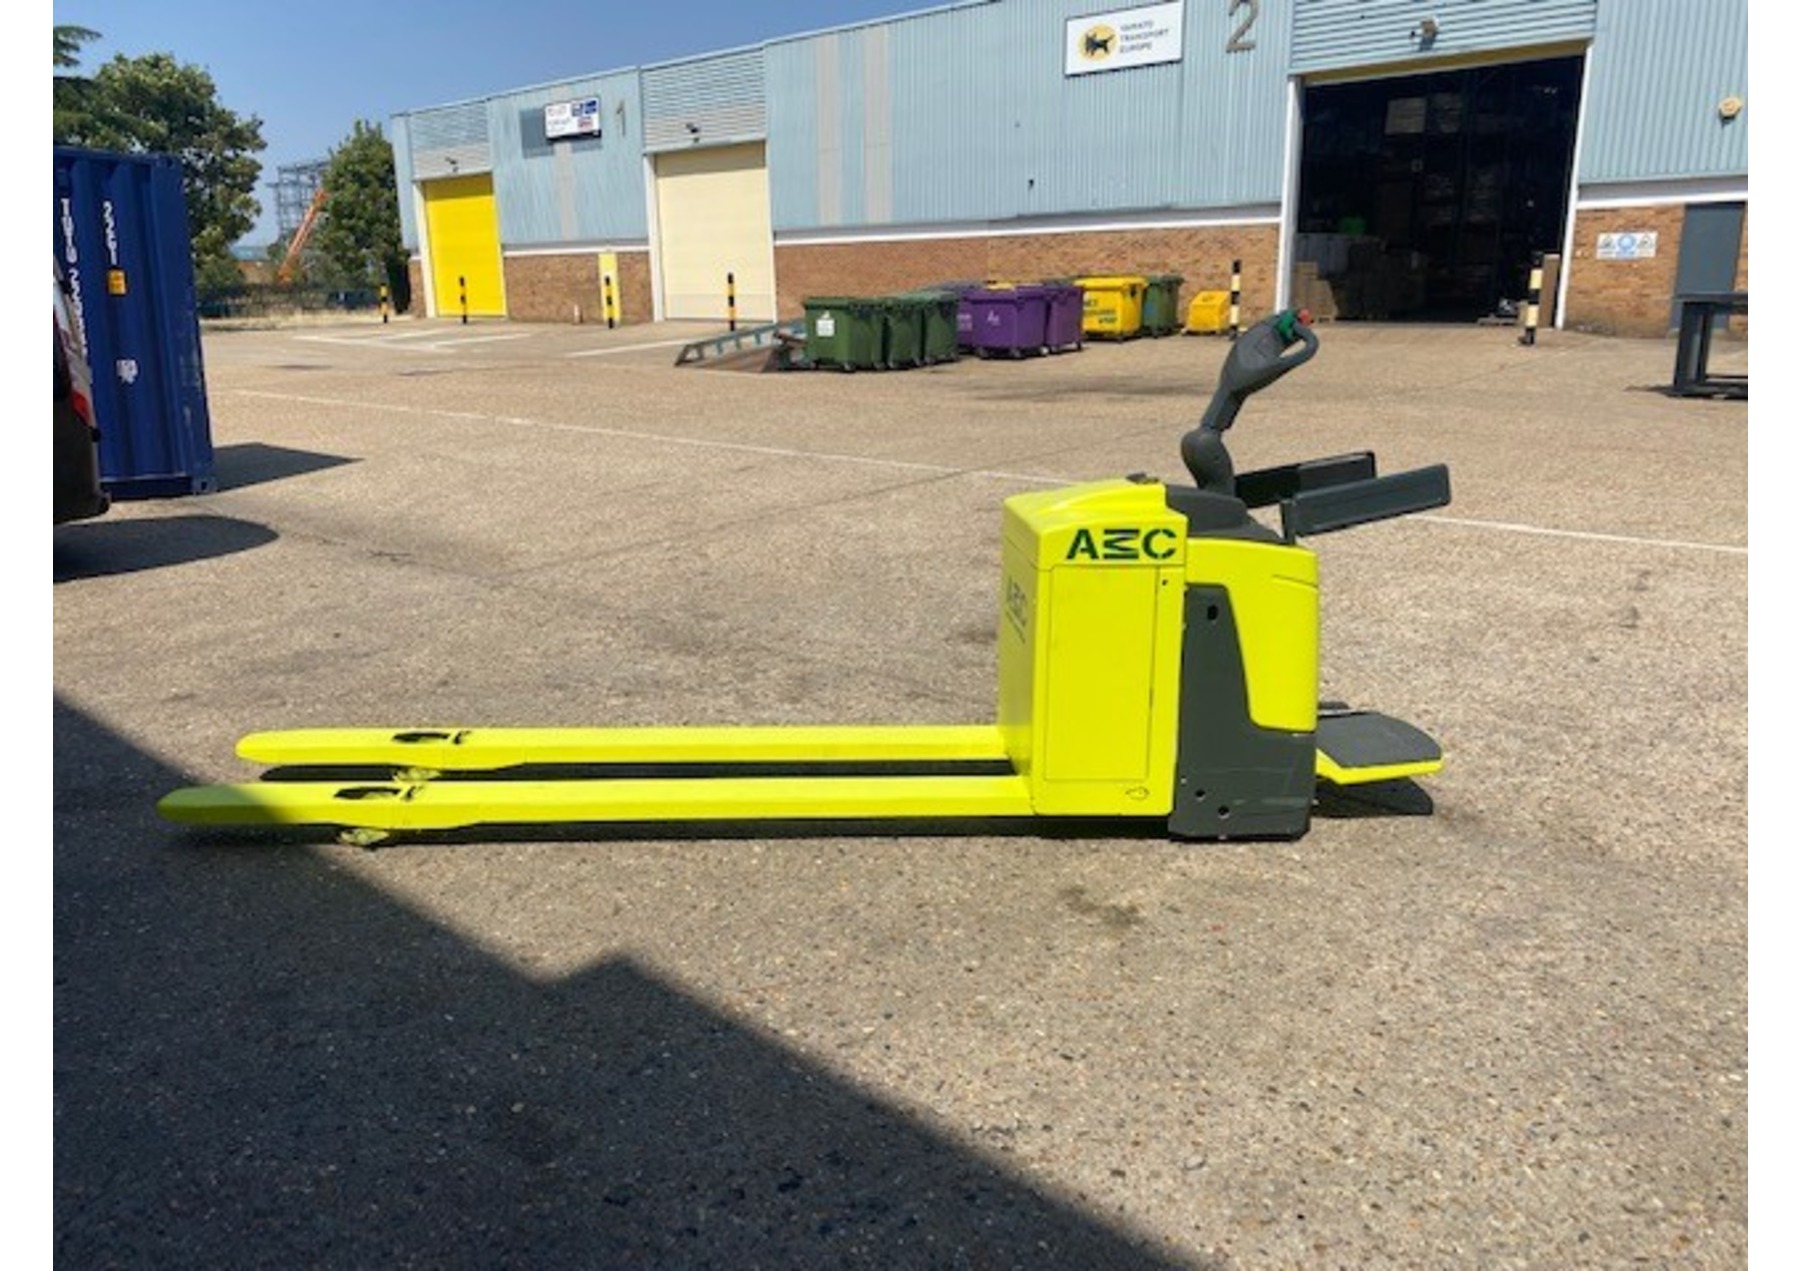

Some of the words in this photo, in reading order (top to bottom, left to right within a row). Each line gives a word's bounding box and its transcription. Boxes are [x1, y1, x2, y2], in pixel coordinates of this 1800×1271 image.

[1120, 28, 1169, 42] TRANSPORT
[1226, 0, 1259, 53] 2
[1120, 42, 1153, 53] EUROPE
[616, 100, 626, 136] 1
